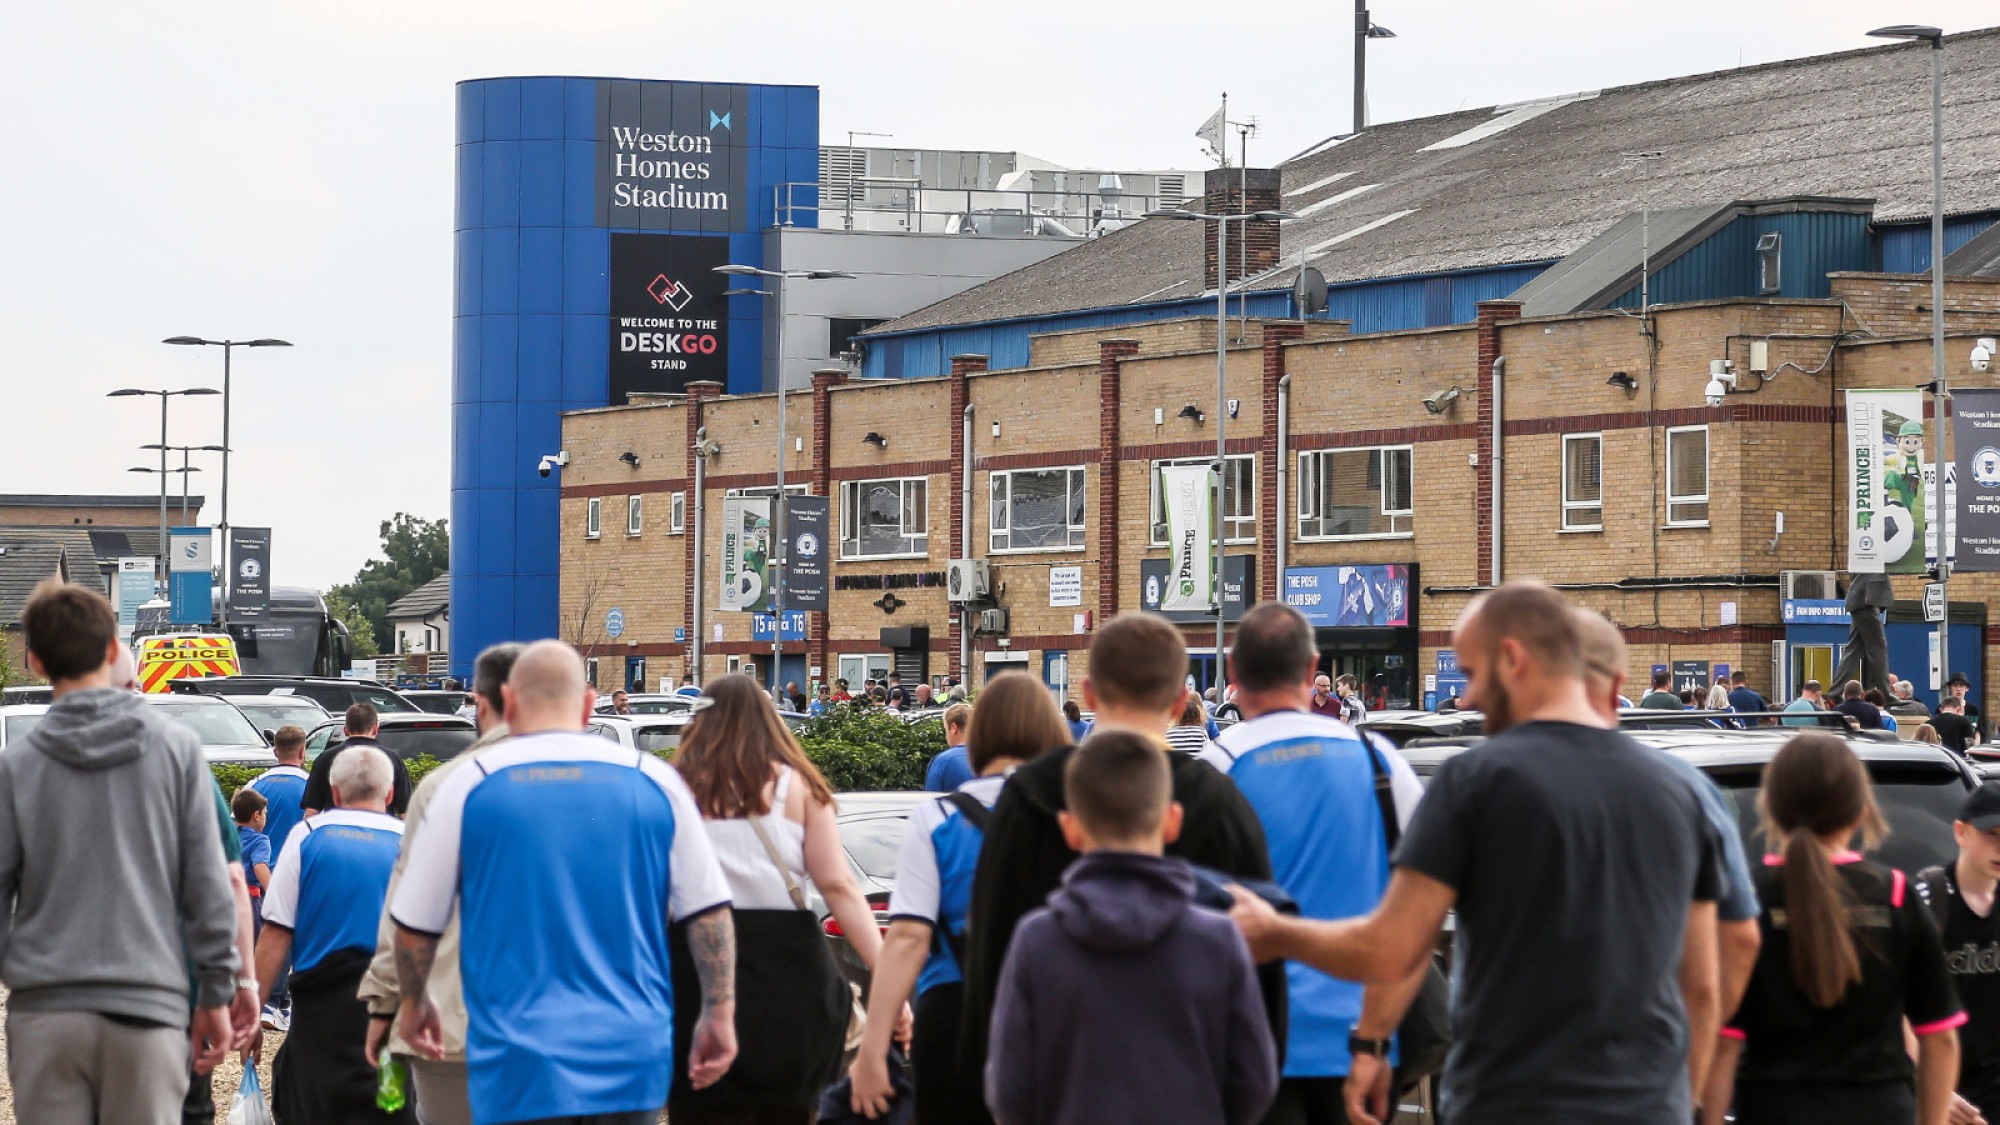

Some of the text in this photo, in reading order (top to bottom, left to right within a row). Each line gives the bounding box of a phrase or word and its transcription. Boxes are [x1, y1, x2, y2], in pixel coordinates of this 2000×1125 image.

[612, 126, 712, 154] Weston
[615, 153, 711, 180] Homes
[614, 182, 729, 210] Stadium
[620, 317, 717, 329] WELCOME TO THE
[620, 332, 717, 354] DESKGO
[650, 359, 687, 370] STAND
[1959, 410, 1986, 418] Weston
[1968, 504, 2000, 513] THE PO
[1962, 537, 1987, 545] Weston
[1287, 575, 1317, 588] THE POSH
[1287, 593, 1322, 606] CLUB SHOP
[1796, 607, 1808, 616] FAN
[1822, 606, 1837, 616] POINT
[754, 615, 766, 633] T5
[792, 614, 804, 633] T6
[146, 649, 230, 661] POLICE
